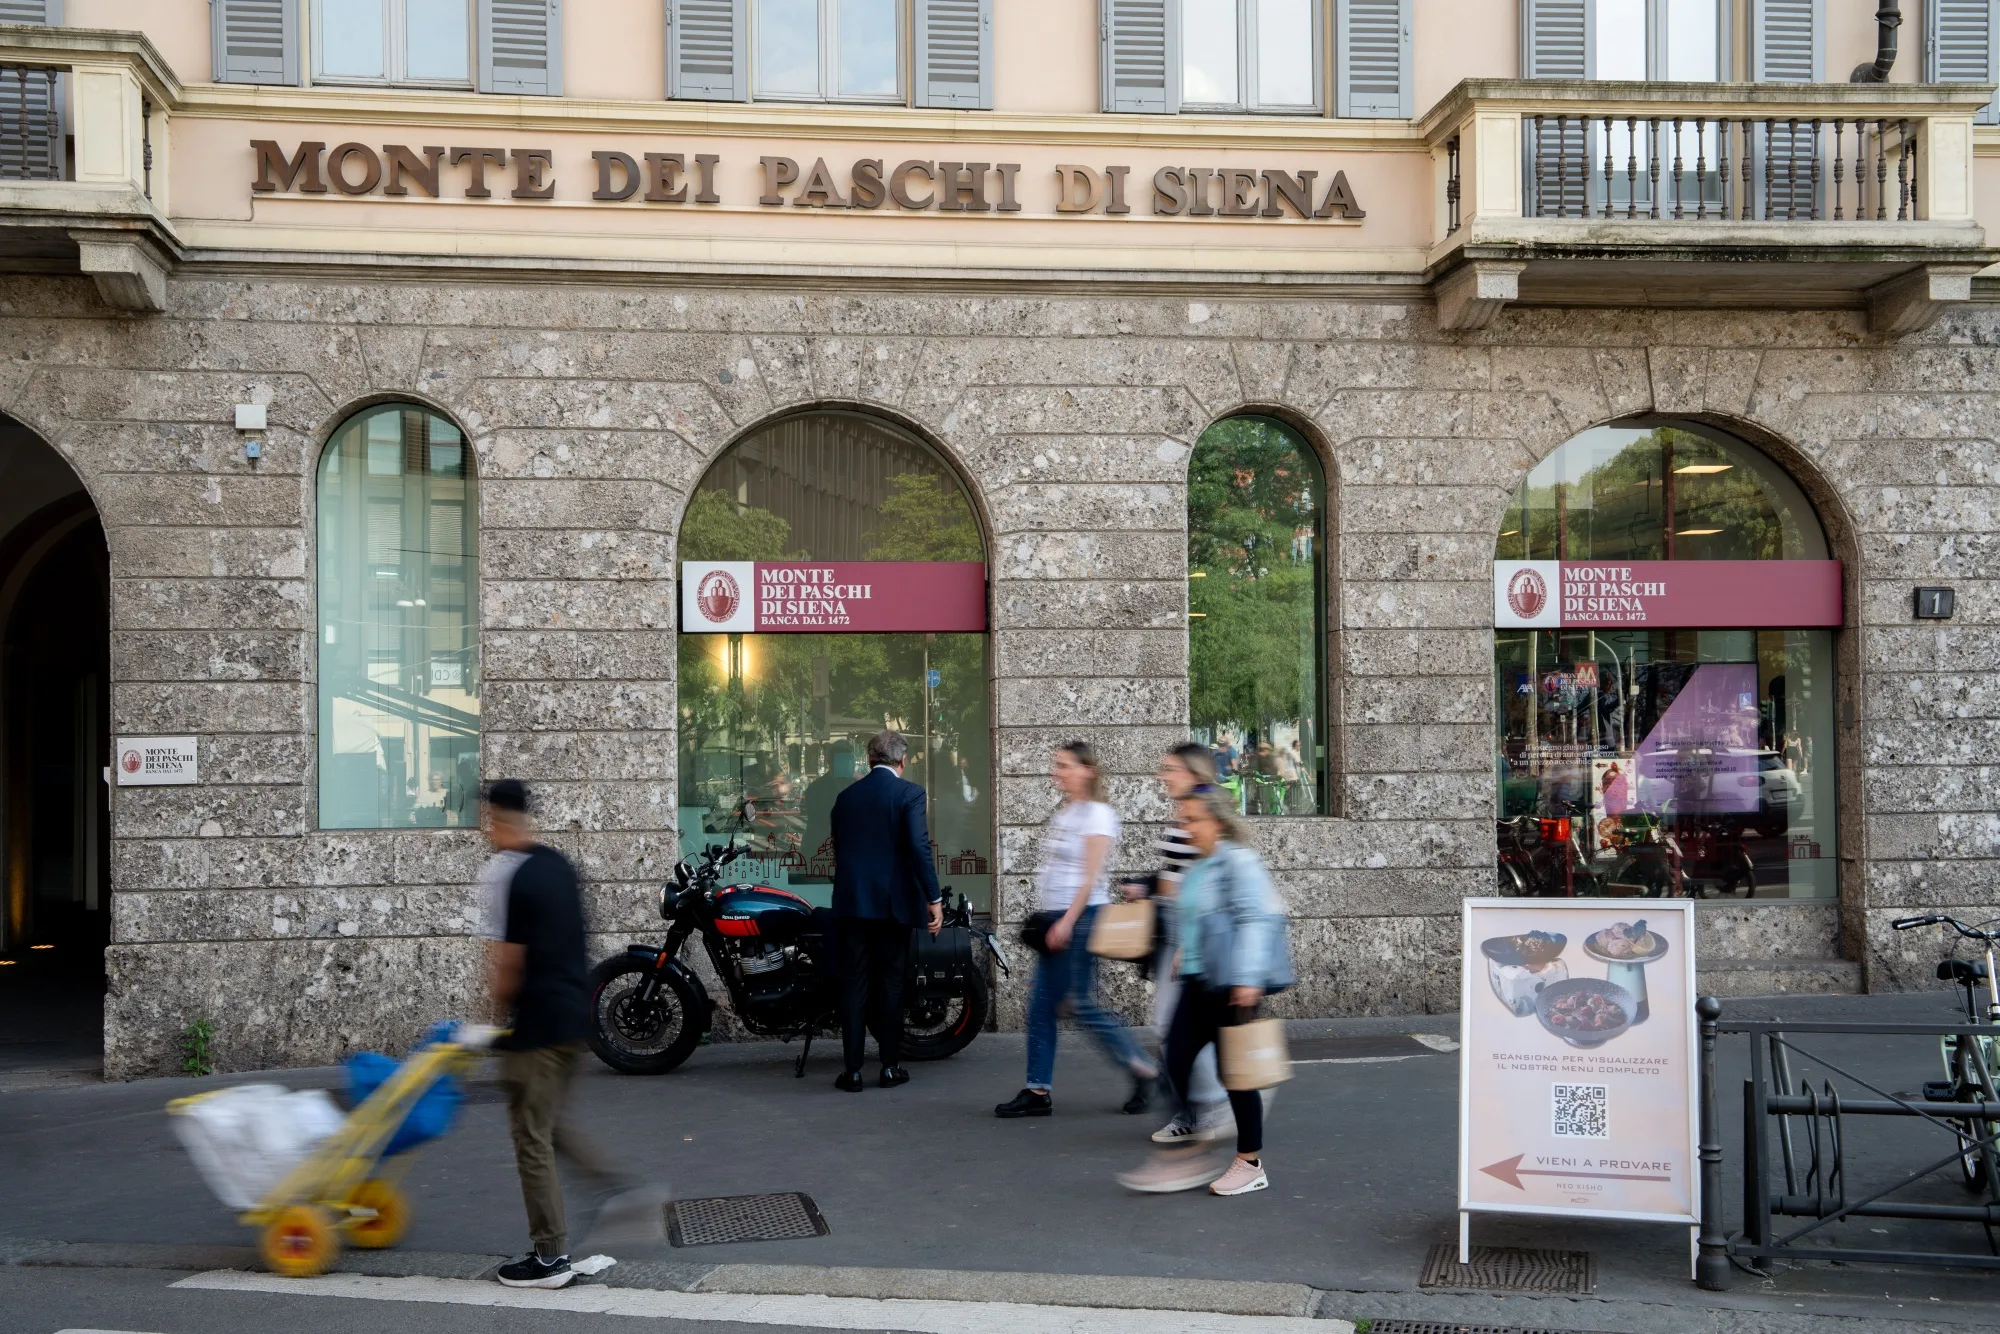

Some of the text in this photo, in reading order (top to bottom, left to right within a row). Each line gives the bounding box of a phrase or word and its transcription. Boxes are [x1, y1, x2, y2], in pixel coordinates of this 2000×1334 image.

[250, 139, 1367, 220] MONTE DEI PASCHI DI SIENA
[760, 569, 835, 583] MONTE
[1564, 567, 1632, 581] MONTE
[761, 585, 872, 599] DEI PASCHI
[1563, 582, 1666, 596] DEI PASCHI
[761, 600, 847, 615] DI SIENA
[1564, 598, 1643, 612] DI SIENA
[1932, 592, 1940, 614] 1
[761, 616, 850, 625] BANCA DAL 1472
[1565, 613, 1647, 621] BANCA DAL 1472
[1516, 684, 1534, 693] AXA
[1563, 743, 1584, 752] giusto
[1519, 751, 1527, 759] di
[1554, 757, 1592, 765] accessibile
[1492, 1053, 1669, 1065] SCANSIONA PER VISUALIZZARE
[1511, 1063, 1557, 1072] NOSTRO
[1562, 1065, 1594, 1073] MENU
[1598, 1066, 1660, 1075] COMPLETO
[1536, 1156, 1672, 1171] VIENI A PROVARE
